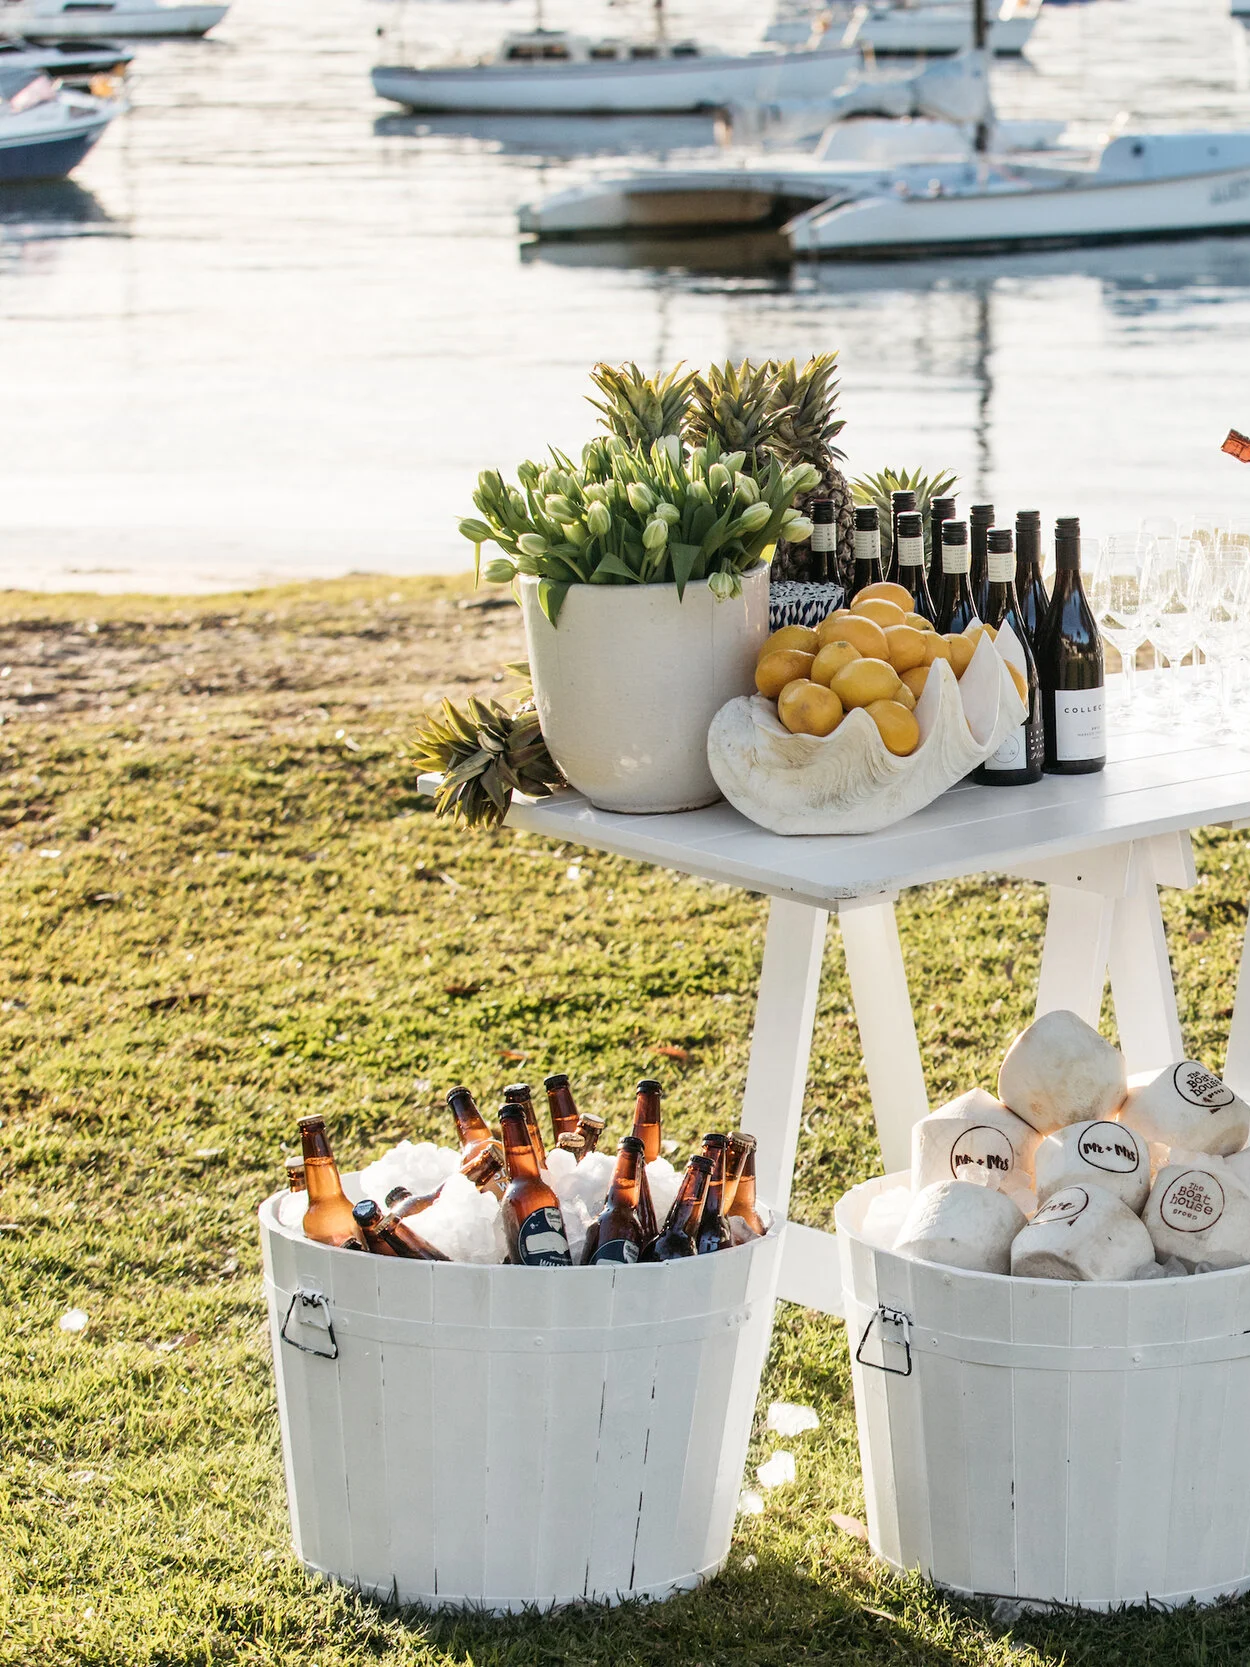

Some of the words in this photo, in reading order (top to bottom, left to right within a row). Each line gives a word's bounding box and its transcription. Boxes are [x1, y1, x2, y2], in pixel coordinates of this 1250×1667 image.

[1064, 703, 1105, 714] COLLEC
[1188, 1182, 1205, 1192] The
[1177, 1186, 1211, 1206] Boat
[1169, 1193, 1213, 1216] house
[1172, 1208, 1198, 1221] group
